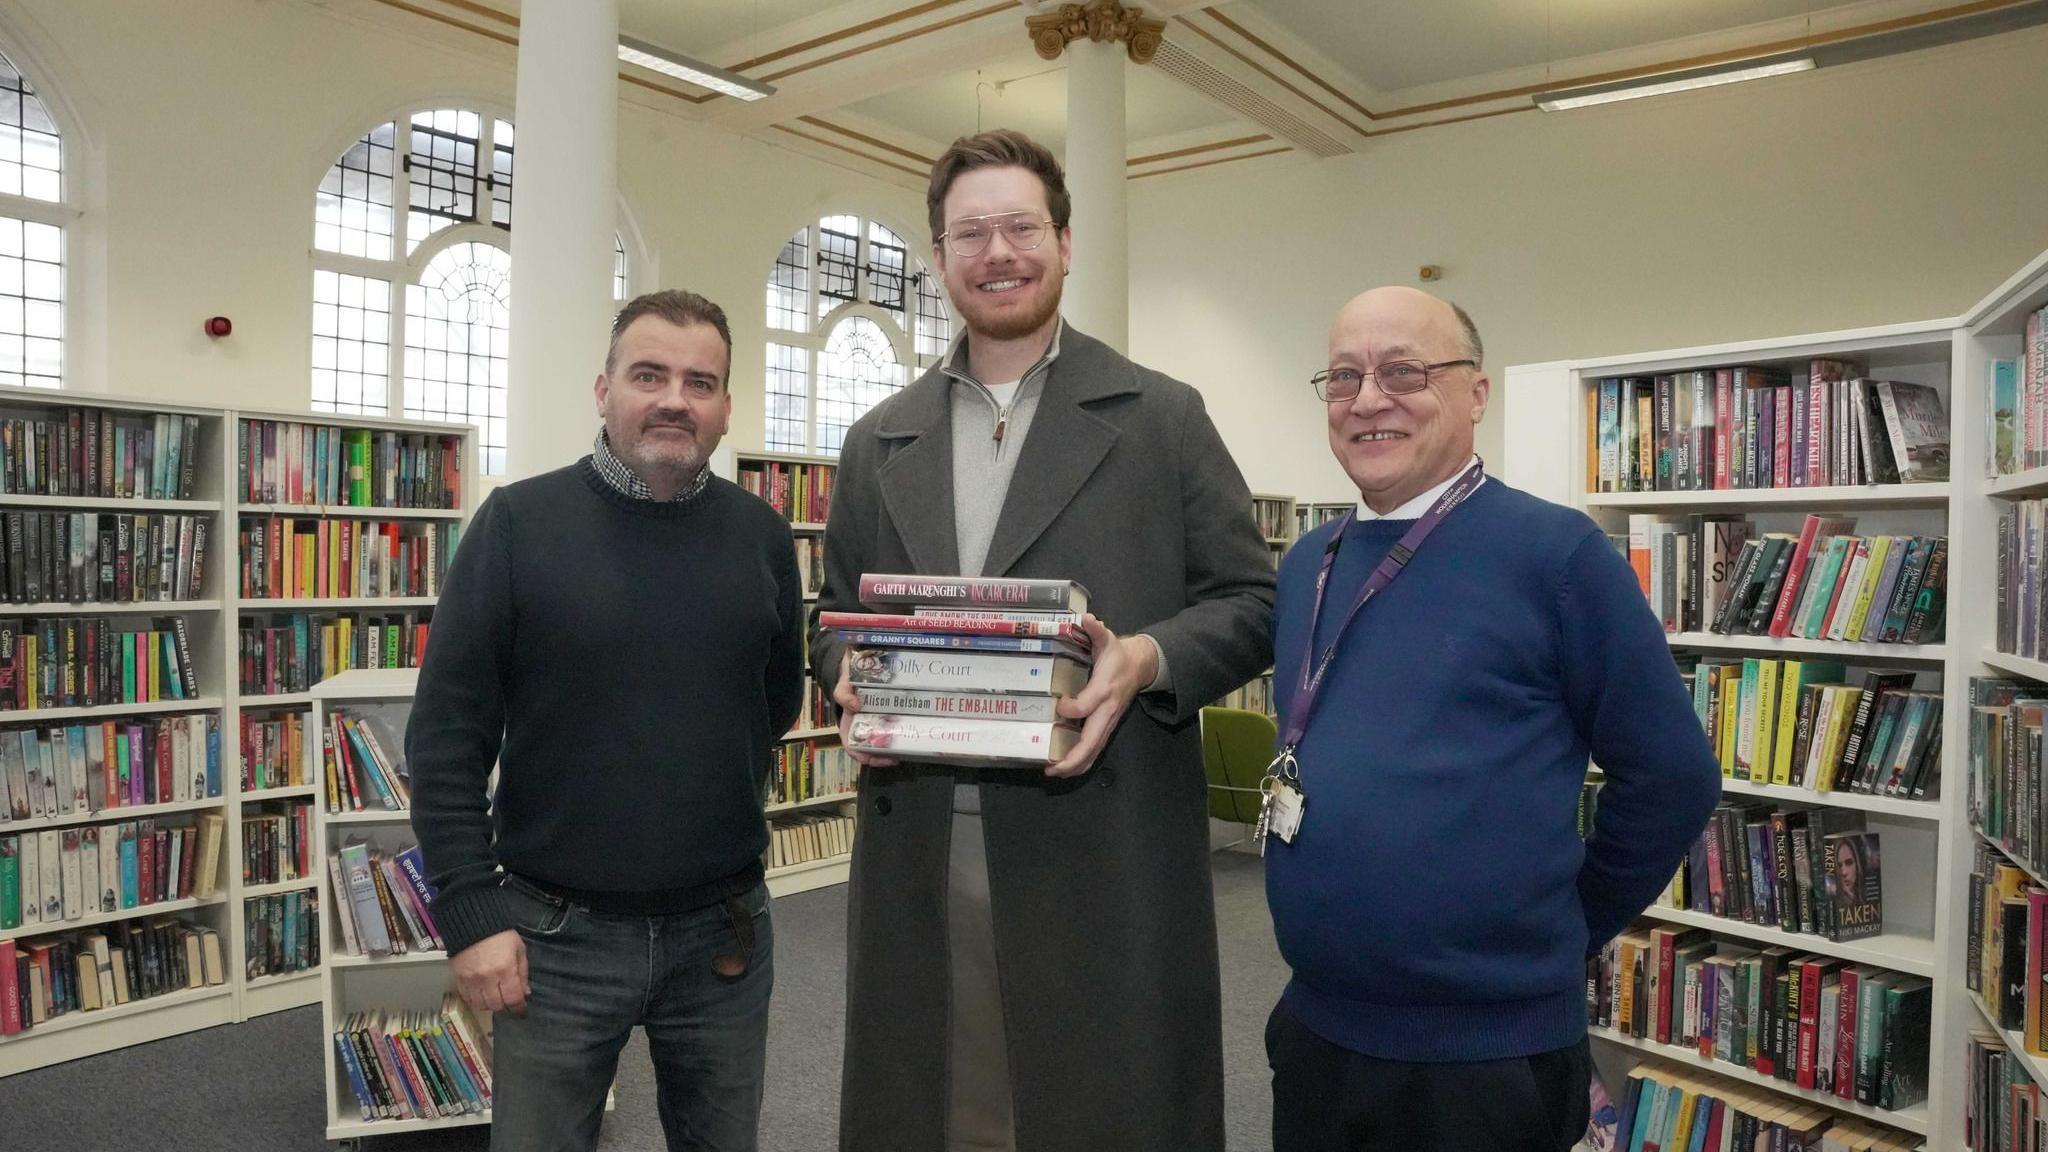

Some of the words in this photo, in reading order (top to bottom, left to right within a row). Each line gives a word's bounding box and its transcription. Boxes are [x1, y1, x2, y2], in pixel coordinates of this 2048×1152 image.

[1661, 381, 1670, 396] ANDY
[1808, 373, 1821, 399] WEST
[1808, 401, 1821, 444] HEART
[1808, 446, 1821, 471] KILL
[873, 583, 906, 596] GARTH
[908, 583, 966, 598] MARENGHI'S
[971, 584, 1031, 602] INCARCERAT
[903, 618, 917, 627] Art
[919, 619, 928, 627] of
[928, 619, 952, 629] SEED
[954, 619, 996, 630] BEADING
[67, 627, 75, 652] JAMES
[870, 635, 905, 645] GRANNY
[906, 636, 945, 646] SQUARES
[176, 619, 191, 664] RAZORBLADE
[185, 667, 196, 690] TEARS
[890, 659, 924, 678] Dilly
[928, 659, 973, 677] Court
[863, 694, 890, 707] Alison
[893, 695, 931, 709] Belsham
[935, 697, 954, 712] THE
[958, 698, 1018, 715] EMBALMER
[928, 726, 973, 742] Court
[1824, 844, 1835, 876] TAKEN
[1838, 903, 1881, 925] TAKEN
[1587, 978, 1596, 1001] TAKEN
[1613, 973, 1622, 995] BURN
[9, 986, 17, 1005] GOOD
[1613, 996, 1622, 1013] THIS
